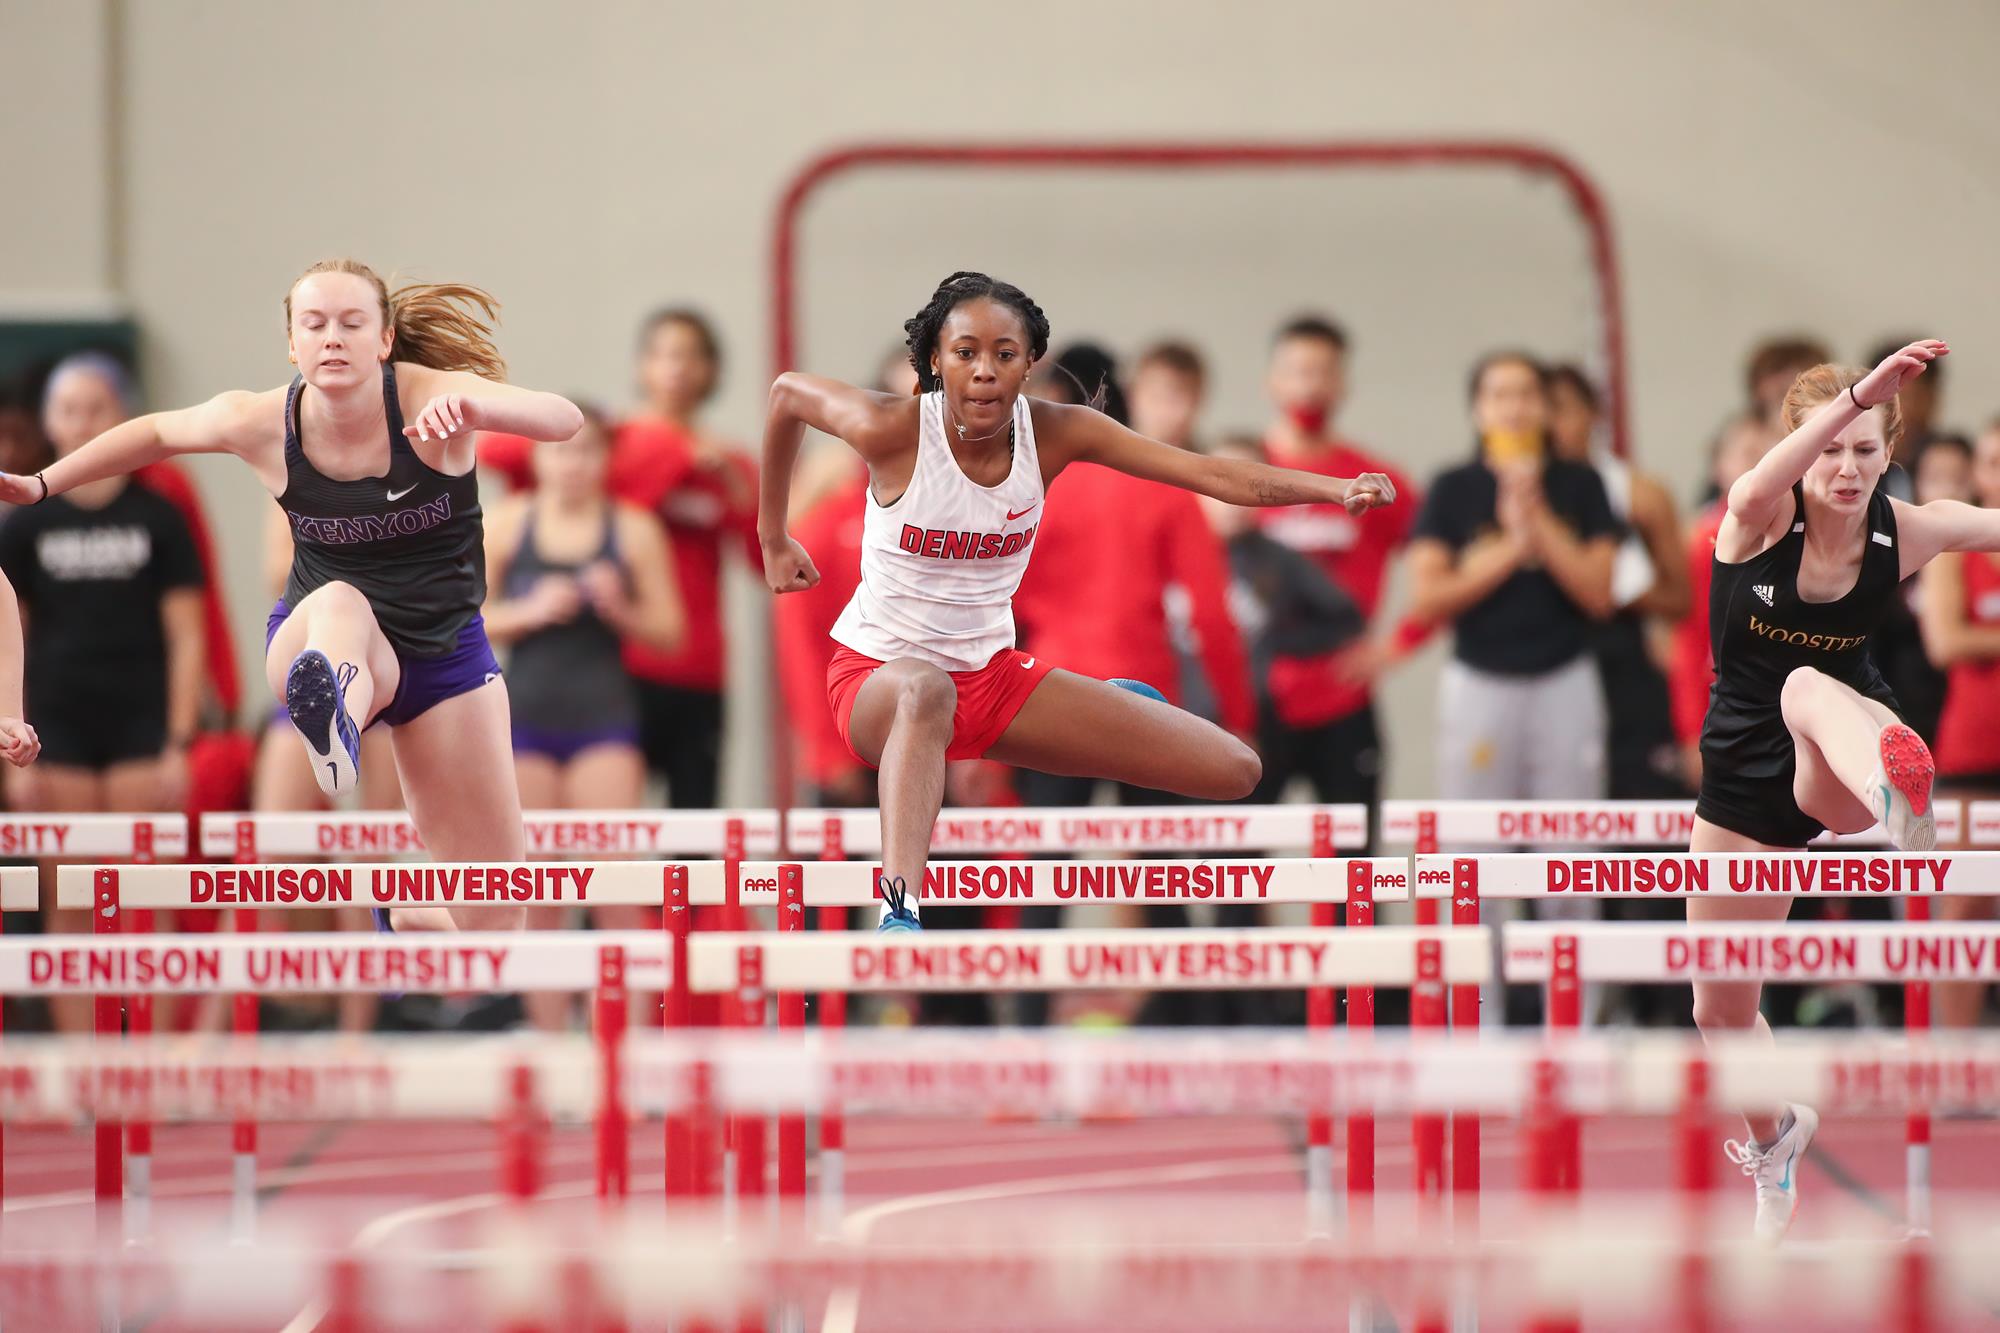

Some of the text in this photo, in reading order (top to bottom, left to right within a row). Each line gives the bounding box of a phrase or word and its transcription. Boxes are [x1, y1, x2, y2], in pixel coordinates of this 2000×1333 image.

[288, 493, 451, 545] KENYON
[1752, 584, 1775, 608] adidas
[525, 821, 662, 850] VERSITY
[1060, 816, 1249, 844] UNIVERSITY
[1498, 811, 1636, 839] DENISON
[190, 867, 594, 902] DENISON UNIVERSITY
[872, 864, 1276, 900] NISON UNIVERSITY
[1547, 857, 1952, 893] DENISON UNIVERSITY
[28, 948, 509, 986] DENISON UNIVERSITY
[851, 941, 1328, 982] DENISON UNIVERSITY
[1665, 937, 1856, 974] DENISON
